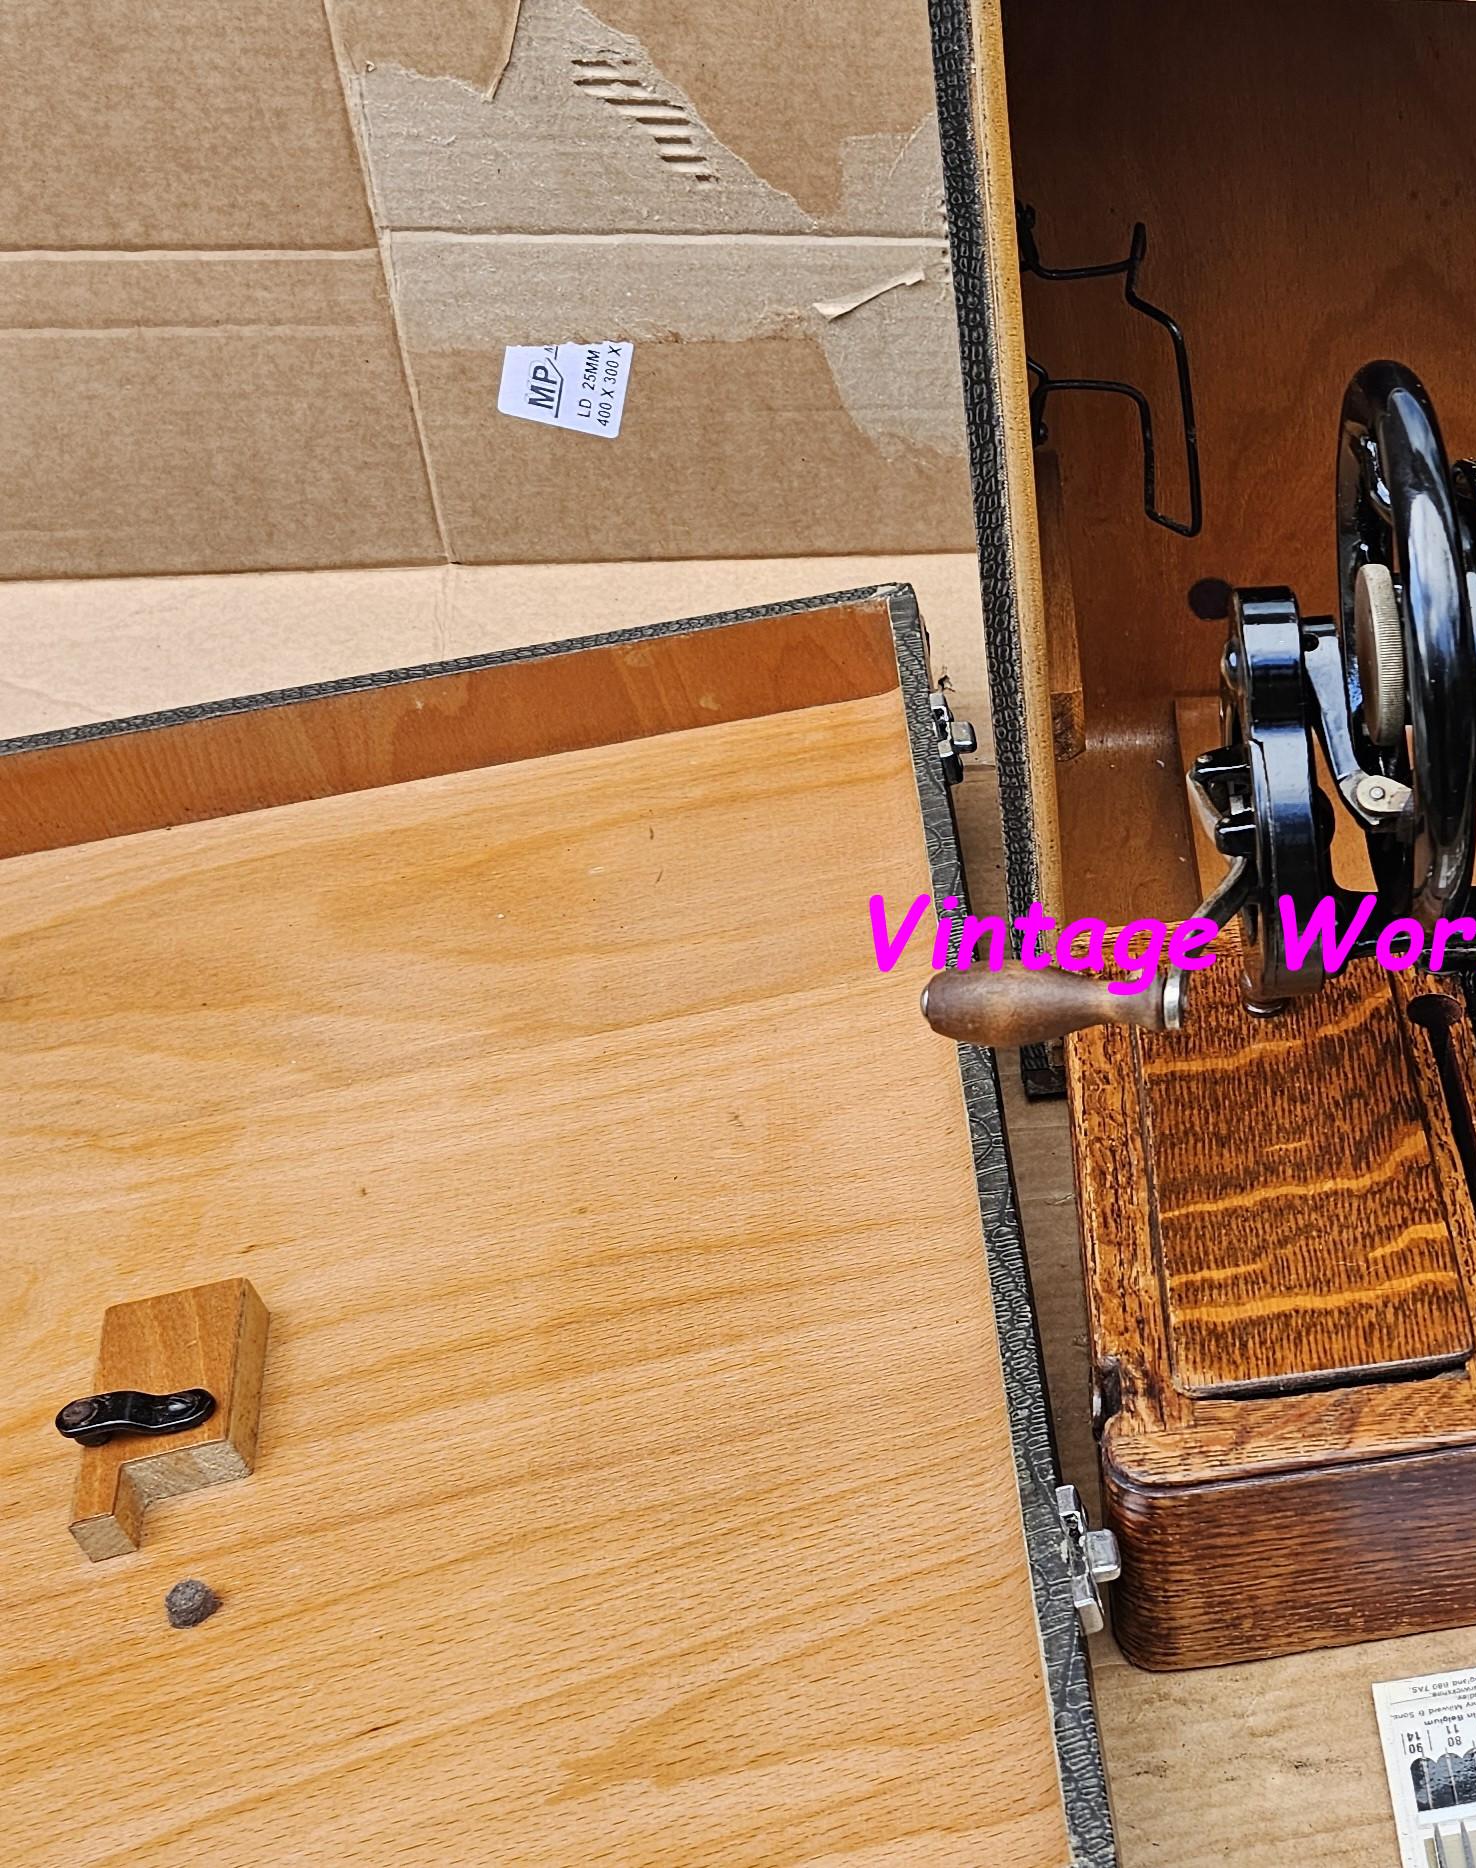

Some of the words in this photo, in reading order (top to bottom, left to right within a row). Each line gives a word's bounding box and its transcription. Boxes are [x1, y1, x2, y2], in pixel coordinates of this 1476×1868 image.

[608, 345, 622, 357] X
[582, 349, 601, 390] 25MM
[604, 360, 620, 385] 300
[527, 364, 558, 410] MP
[600, 388, 615, 399] X
[577, 398, 592, 418] LD
[597, 402, 613, 426] 400
[1423, 1713, 1464, 1726] Belgium
[1465, 1712, 1476, 1720] in
[1445, 1724, 1460, 1734] 11
[1406, 1731, 1421, 1741] 14
[1447, 1736, 1462, 1747] 80
[1408, 1743, 1423, 1754] 90
